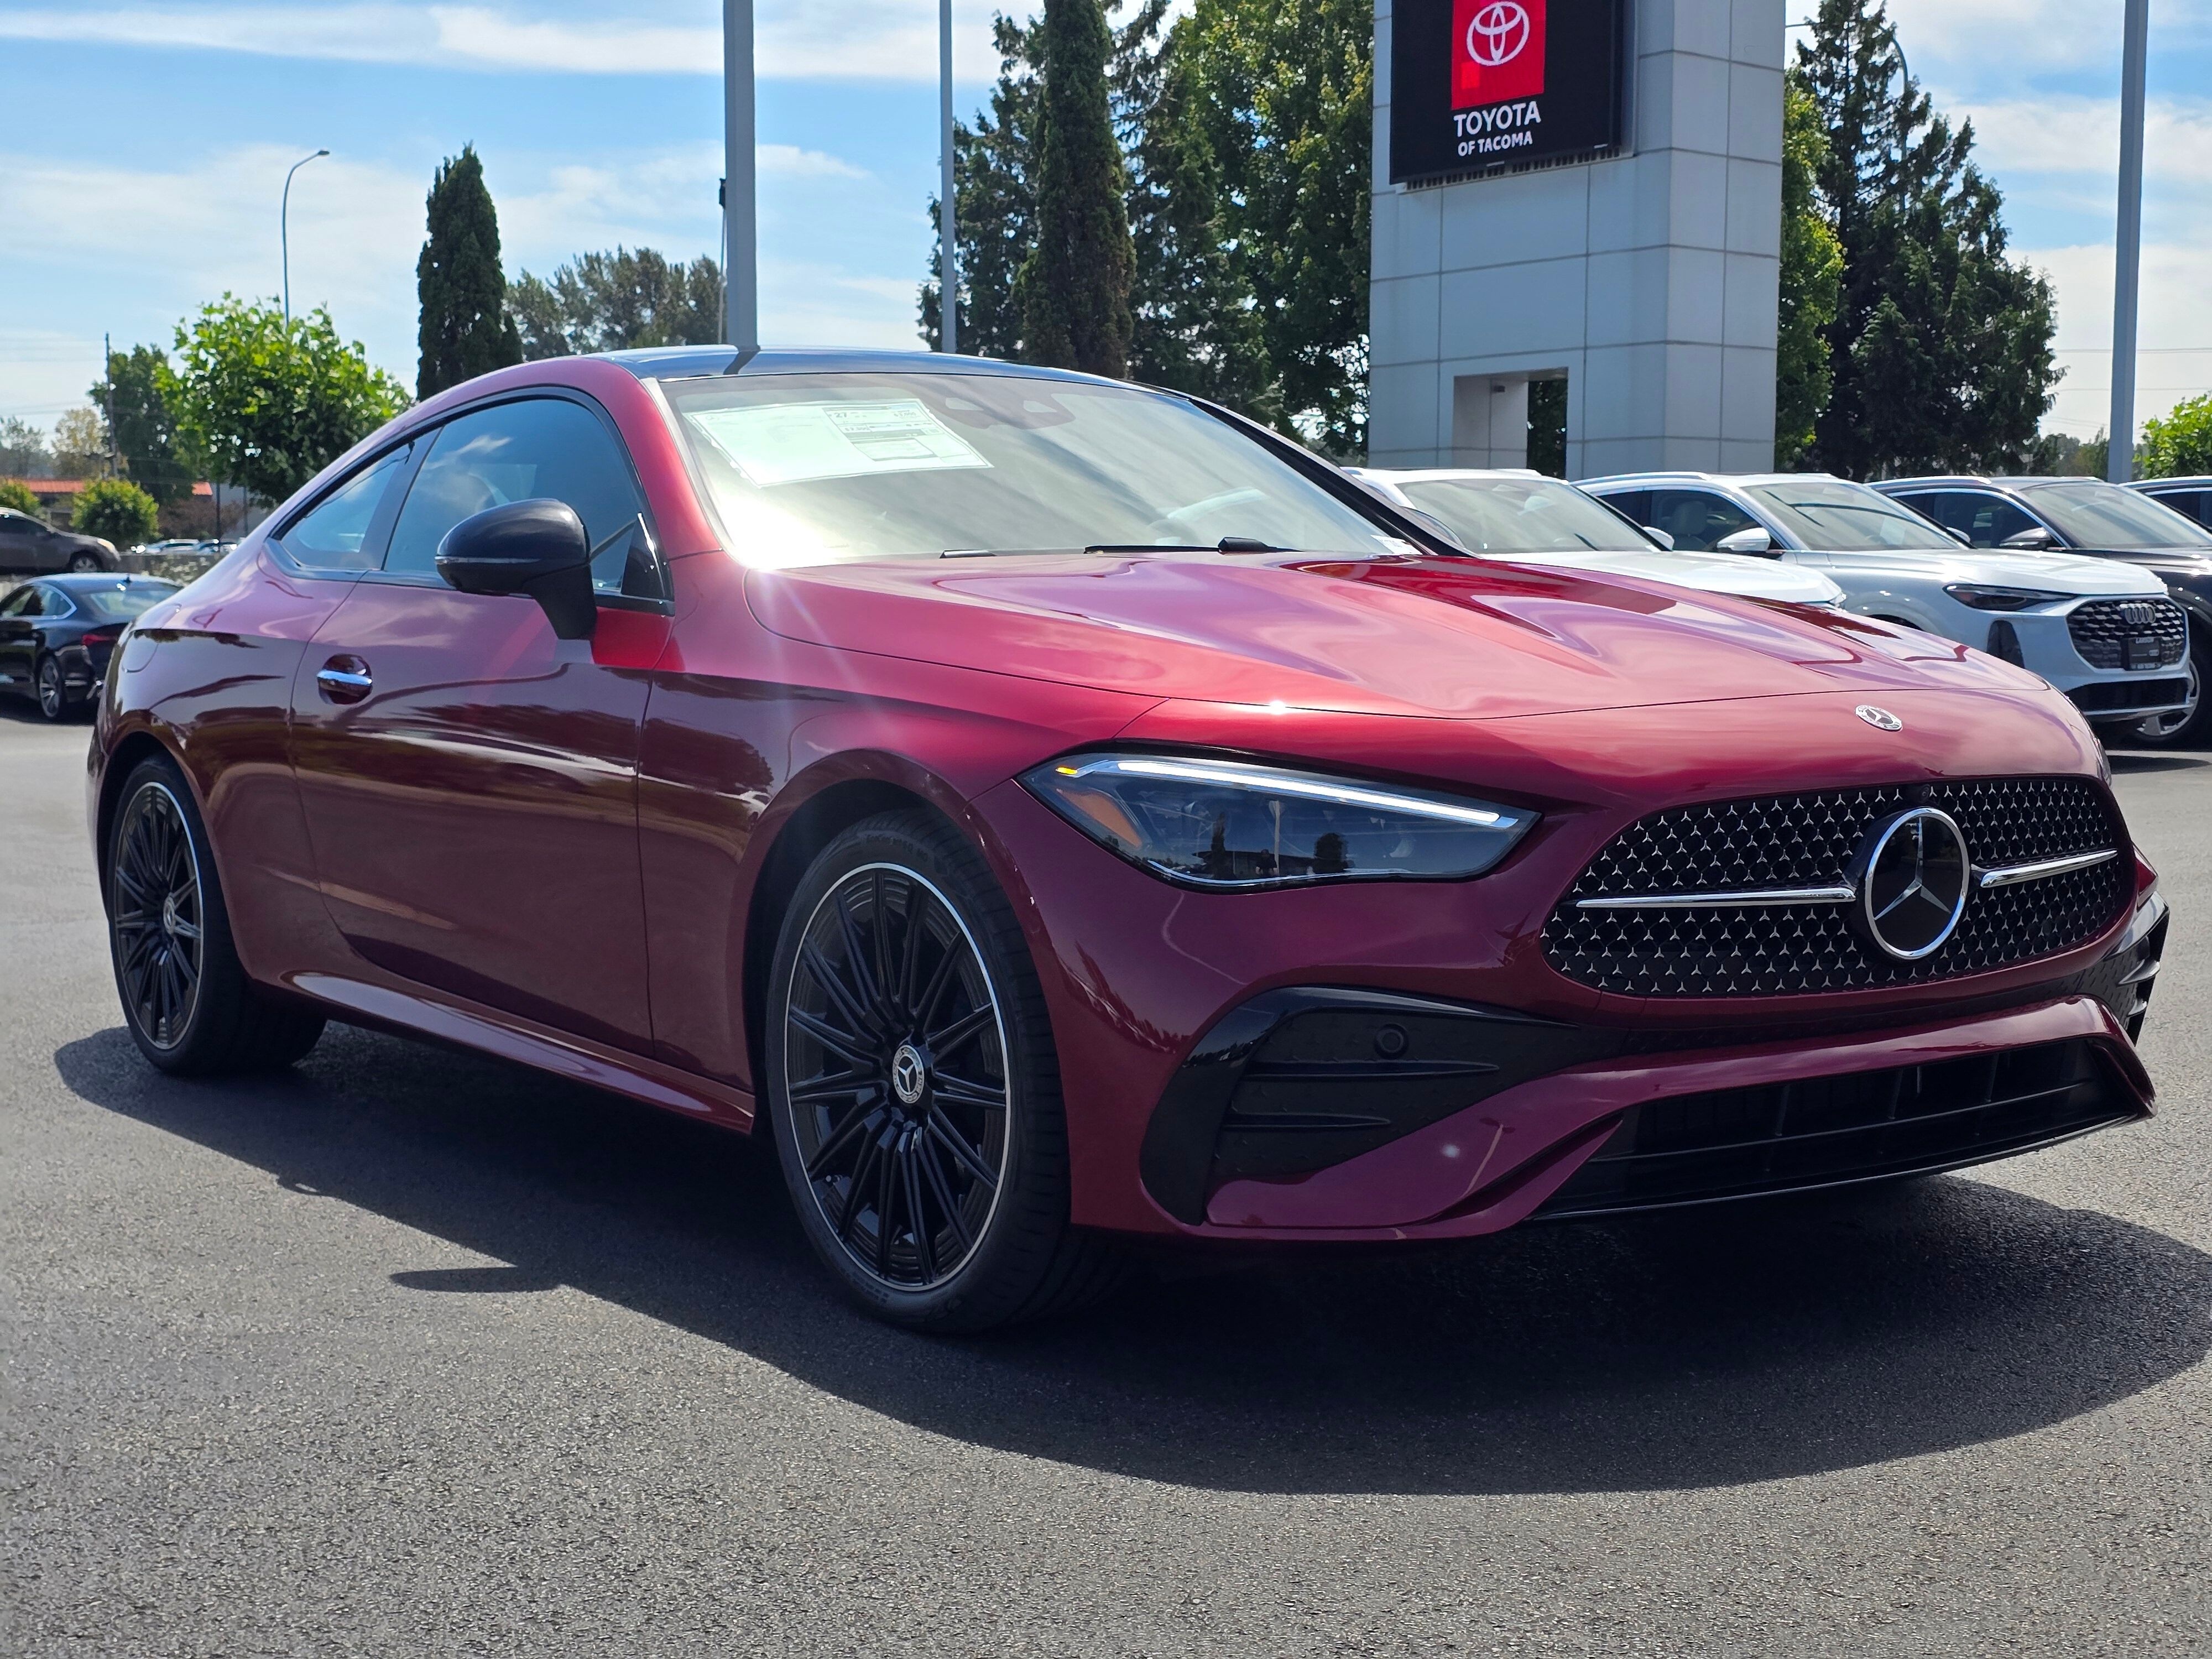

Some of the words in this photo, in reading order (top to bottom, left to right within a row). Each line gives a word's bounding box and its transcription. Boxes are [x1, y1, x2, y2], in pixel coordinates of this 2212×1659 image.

[1454, 101, 1541, 137] TOYOTA
[1458, 140, 1475, 156] OF
[1478, 131, 1532, 153] TACOMA
